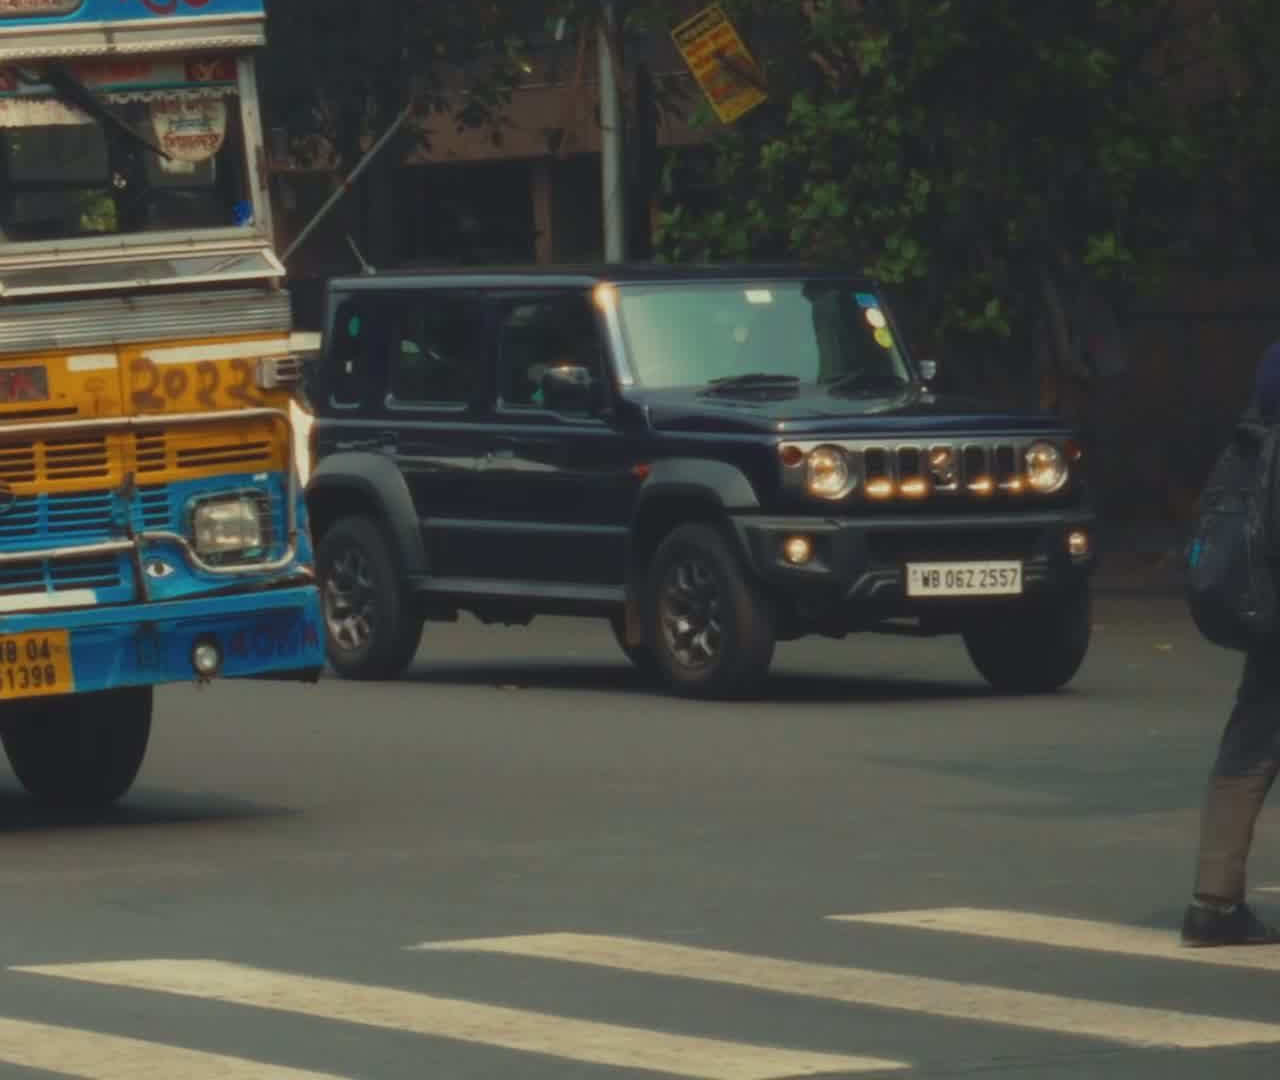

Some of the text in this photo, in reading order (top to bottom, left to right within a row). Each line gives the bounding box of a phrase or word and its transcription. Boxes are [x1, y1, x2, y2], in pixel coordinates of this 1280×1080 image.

[921, 570, 940, 589] WB
[978, 568, 1019, 588] 2557
[26, 637, 52, 662] 04
